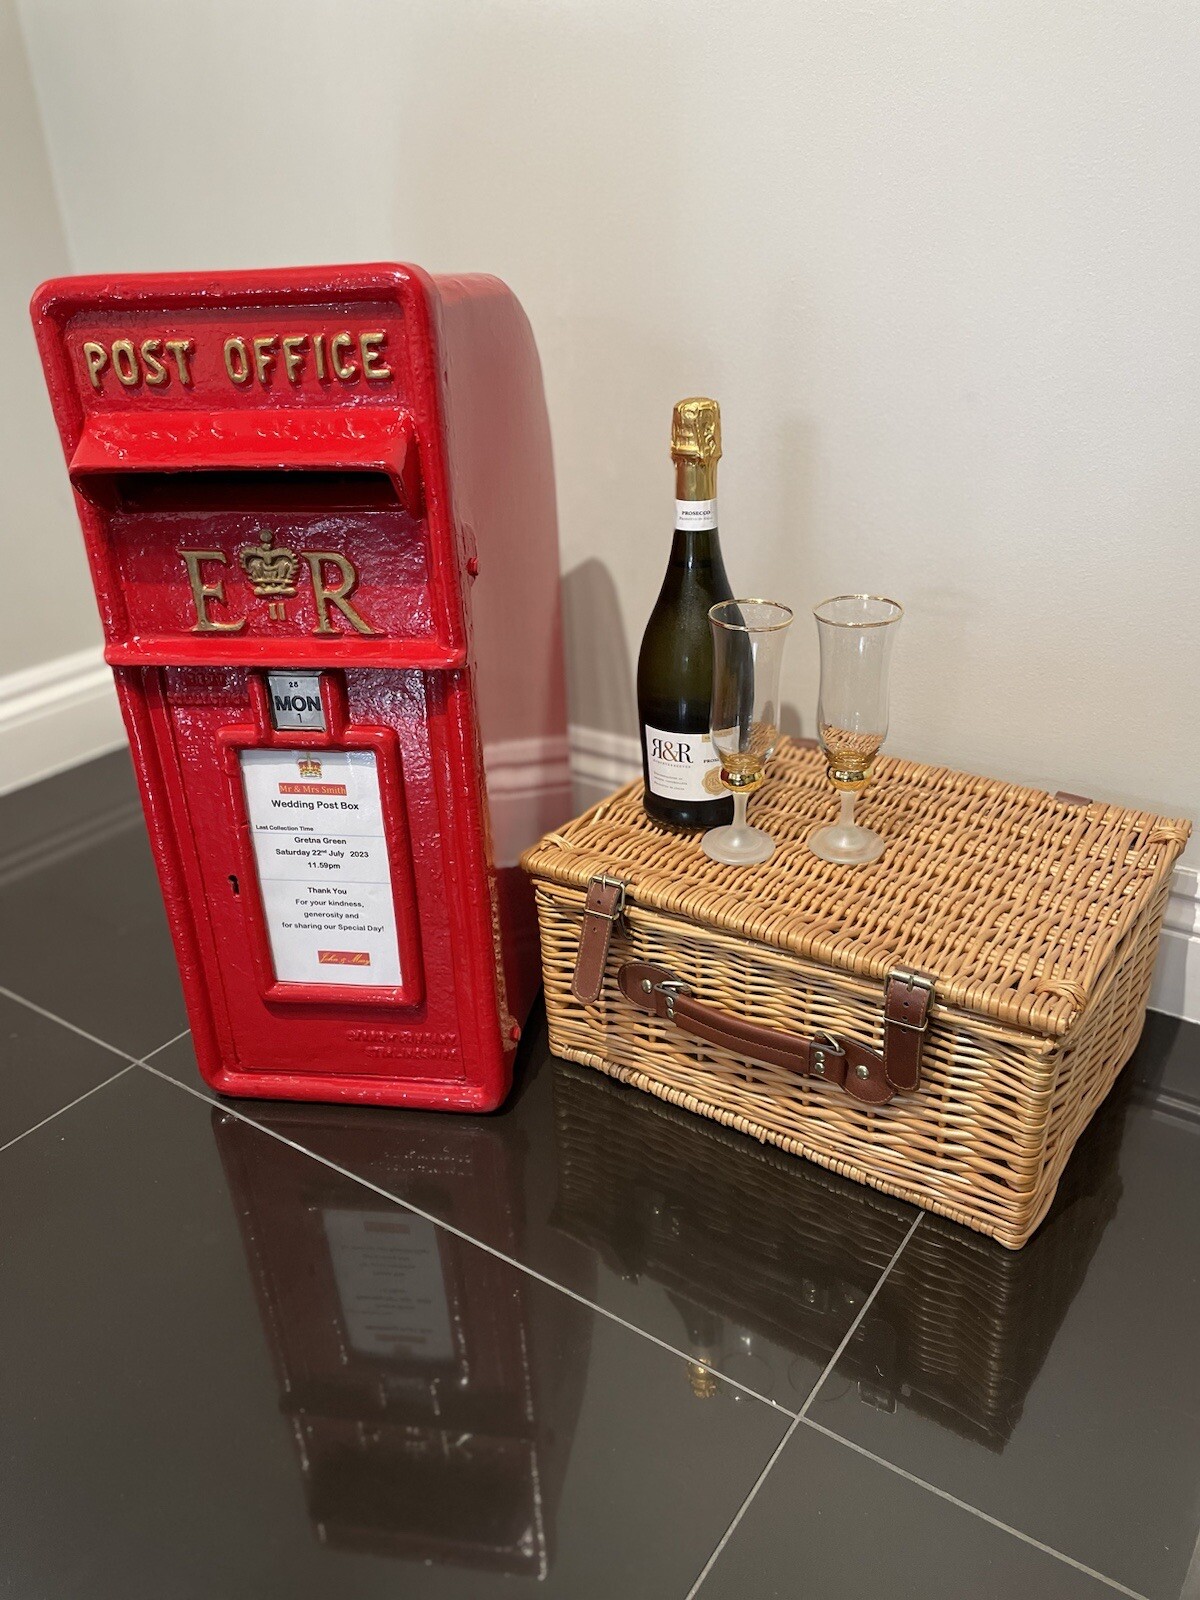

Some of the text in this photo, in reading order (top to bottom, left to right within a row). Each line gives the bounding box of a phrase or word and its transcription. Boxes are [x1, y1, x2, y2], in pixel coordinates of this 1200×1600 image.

[83, 330, 392, 388] POST OFFICE
[178, 550, 385, 635] E R
[274, 695, 322, 712] MON
[280, 783, 347, 795] Mr & Mrs Smith
[271, 799, 359, 811] Wedding Post Box
[294, 836, 347, 845] Gretna Green
[275, 848, 311, 857] Saturday
[328, 850, 345, 858] July
[349, 850, 369, 858] 2023
[307, 861, 341, 870] 11.59pm
[332, 887, 347, 895] You
[328, 899, 365, 908] kindness,
[303, 911, 344, 919] generosity
[294, 922, 323, 930] sharing
[338, 923, 366, 932] Special
[367, 925, 385, 933] Day!
